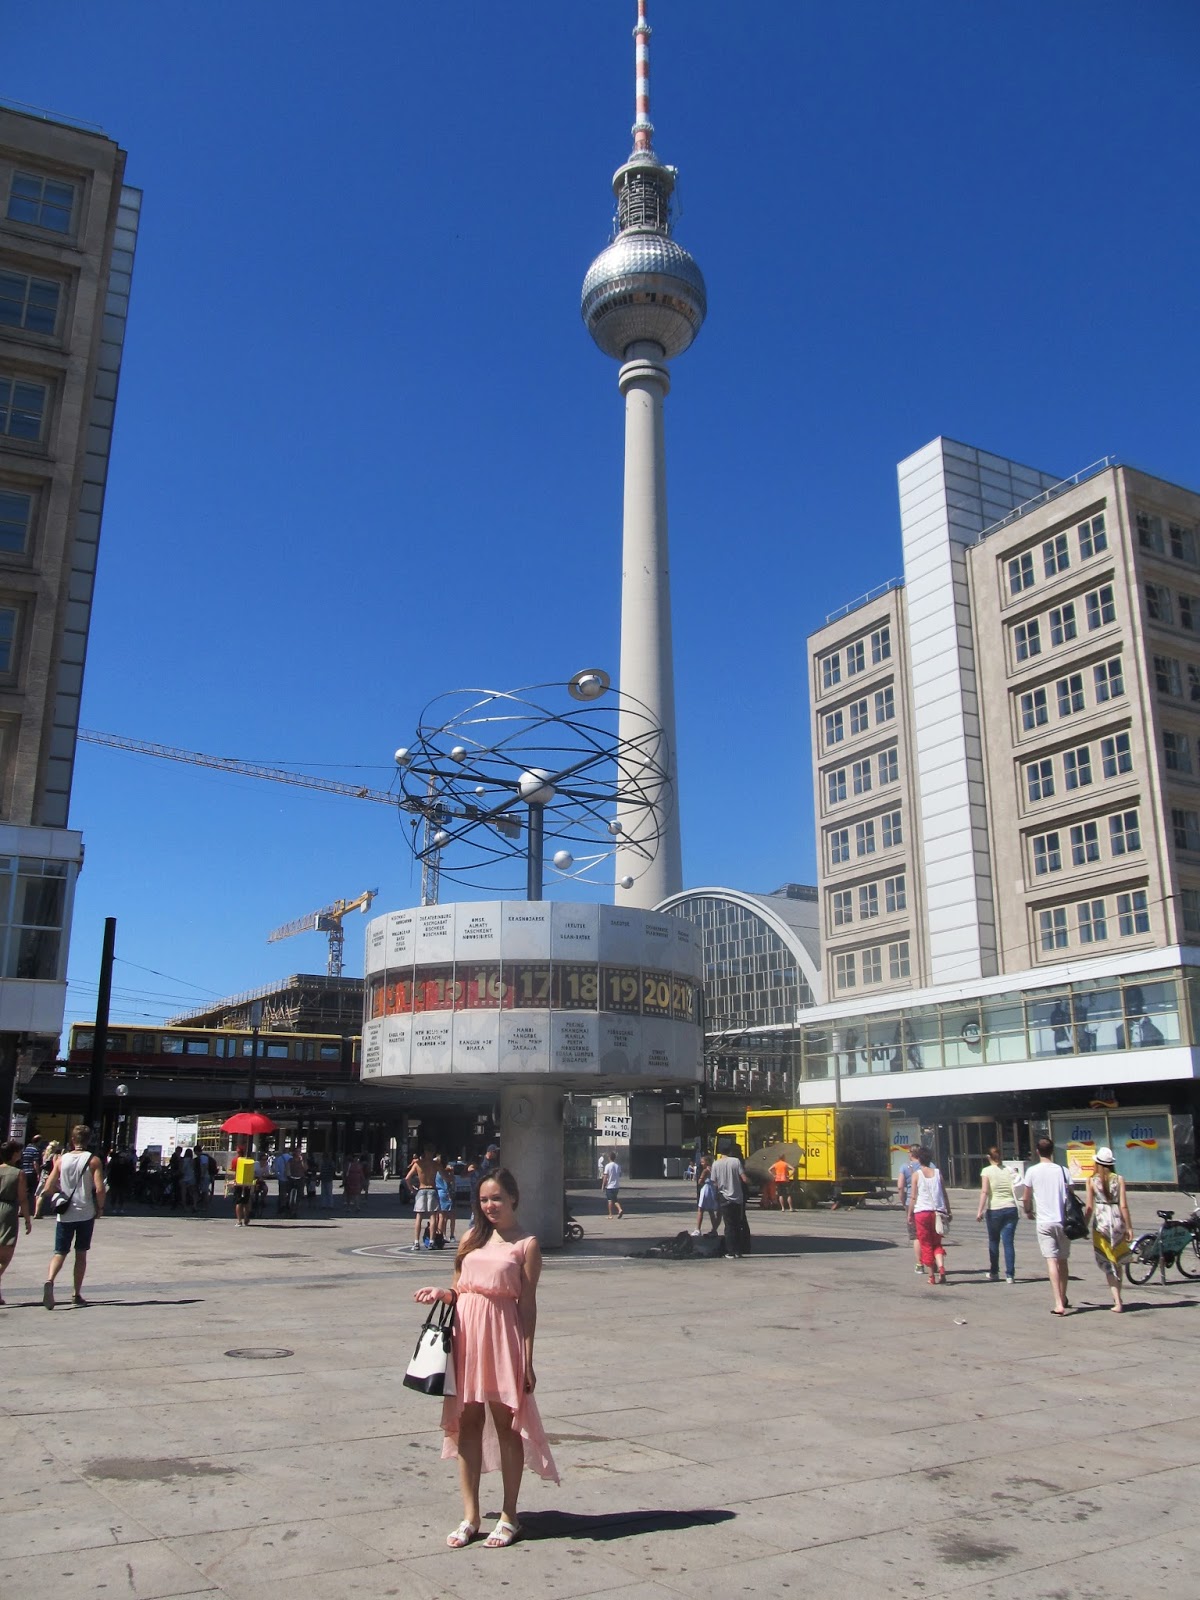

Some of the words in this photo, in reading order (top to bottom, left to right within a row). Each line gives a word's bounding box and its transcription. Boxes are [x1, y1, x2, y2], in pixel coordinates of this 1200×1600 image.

[435, 978, 463, 1001] 15
[475, 971, 509, 1000] 16
[520, 971, 555, 999] 17
[567, 973, 598, 1000] 18
[609, 976, 639, 1003] 19
[644, 979, 670, 1008] 20
[673, 983, 687, 1011] 21
[604, 1116, 631, 1124] RENT
[1131, 1124, 1153, 1139] dm
[604, 1130, 628, 1138] BIKE
[893, 1131, 909, 1145] dm
[1071, 1126, 1092, 1141] dm
